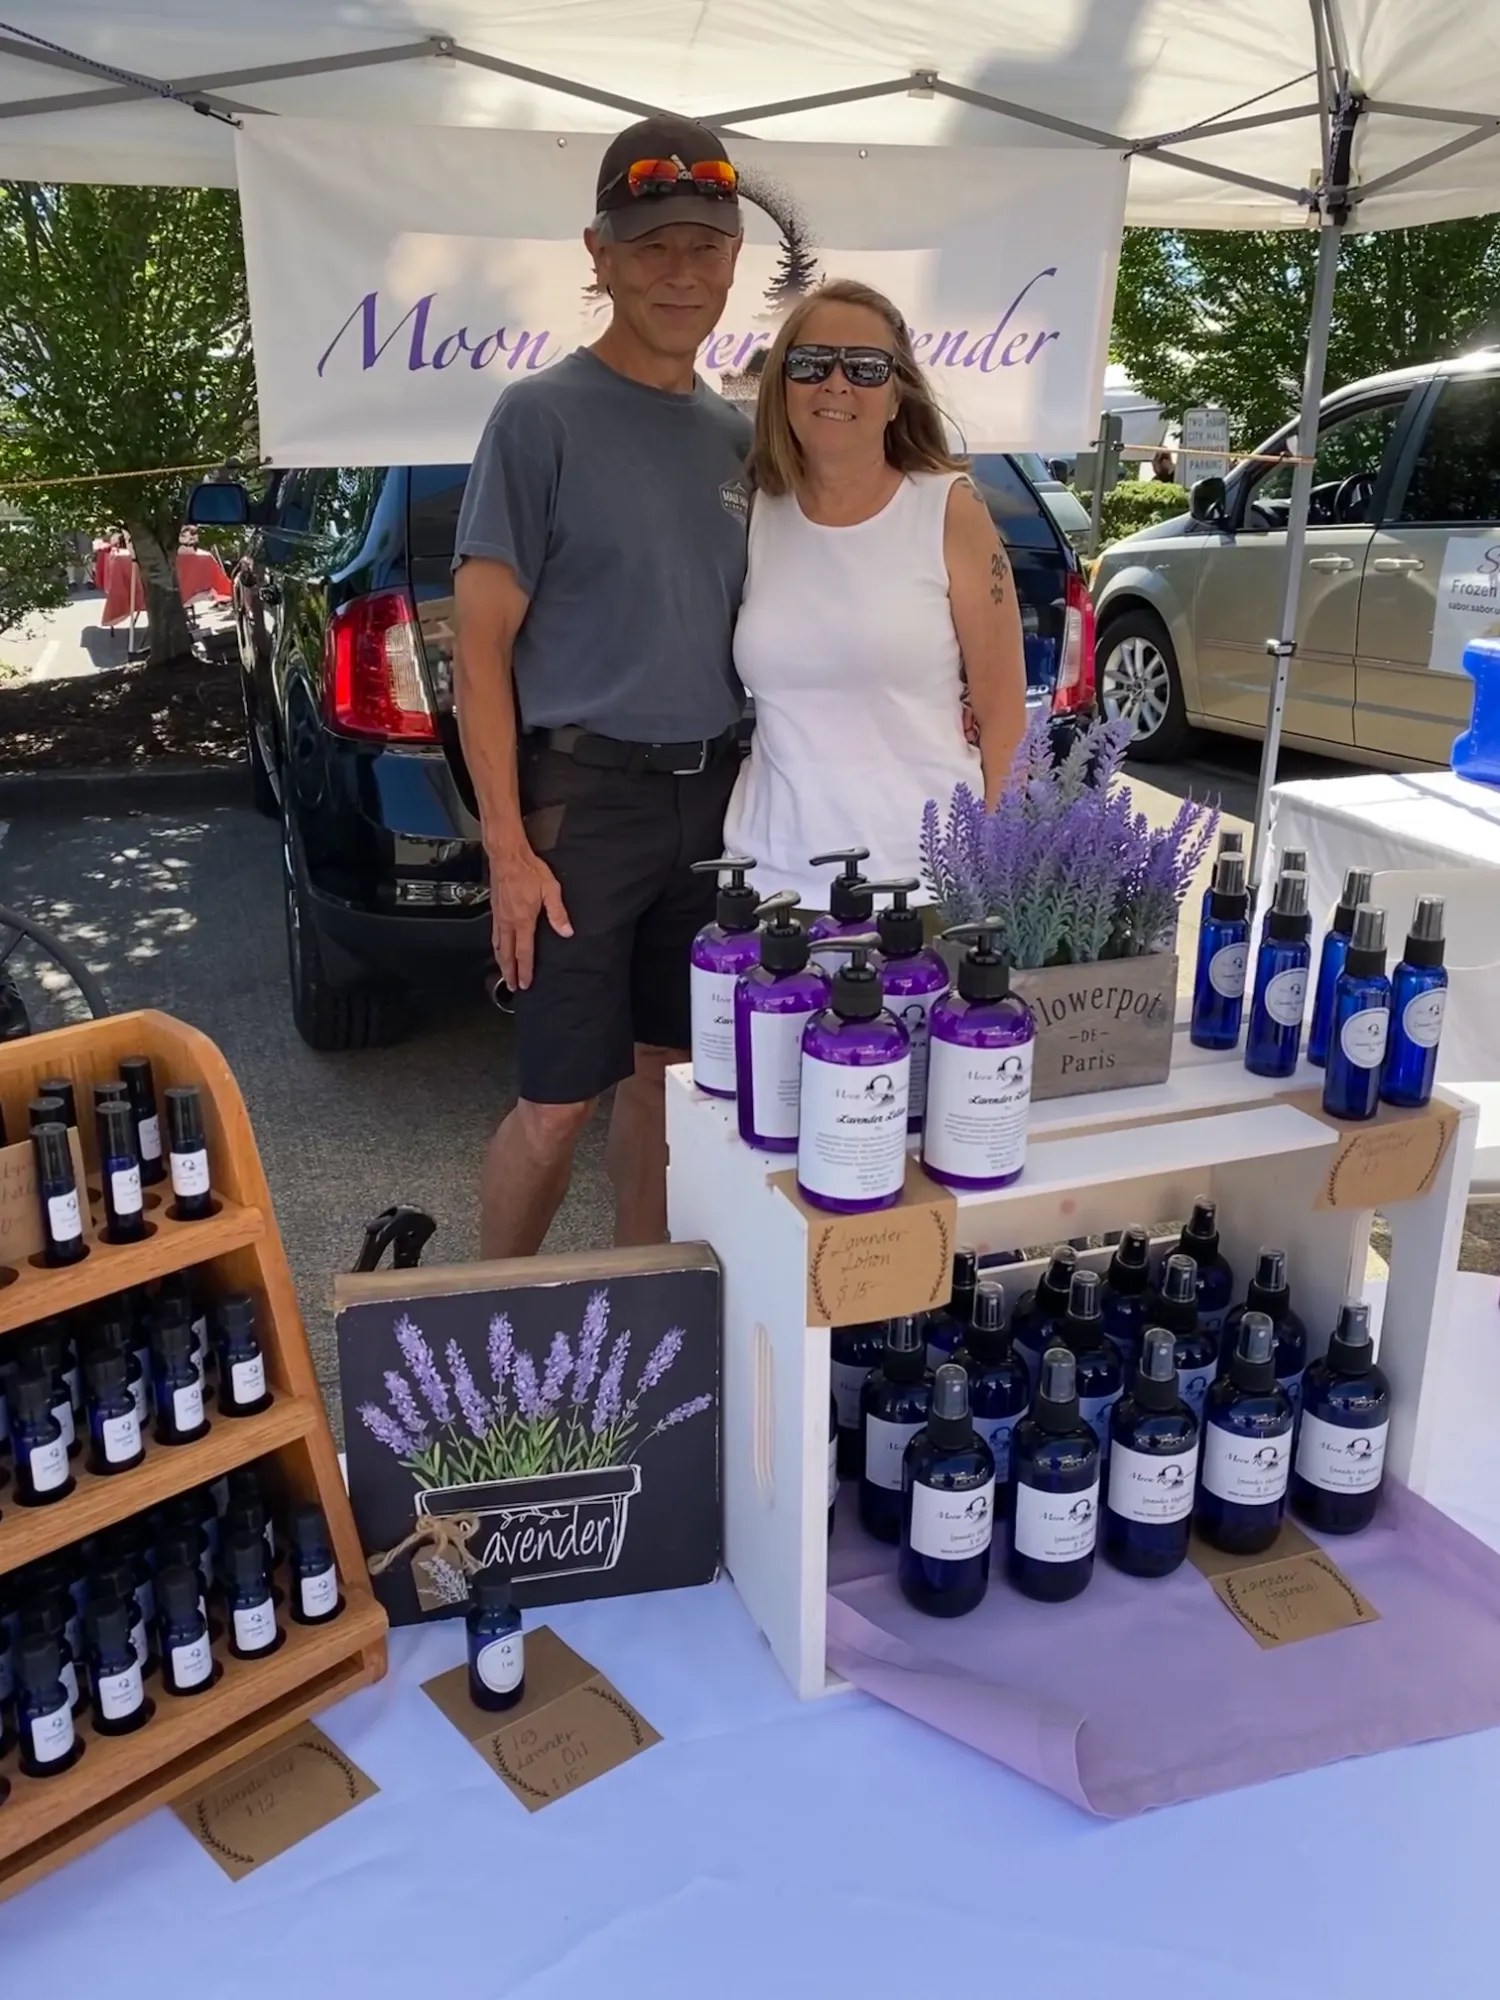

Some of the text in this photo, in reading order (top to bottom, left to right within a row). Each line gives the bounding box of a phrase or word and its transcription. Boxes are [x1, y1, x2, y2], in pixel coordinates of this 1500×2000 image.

[318, 290, 558, 378] Moon
[909, 267, 1060, 373] ender
[1451, 579, 1497, 598] Frozen
[1031, 986, 1162, 1027] lowerpot
[1060, 1050, 1116, 1075] Paris
[482, 1503, 611, 1569] avender
